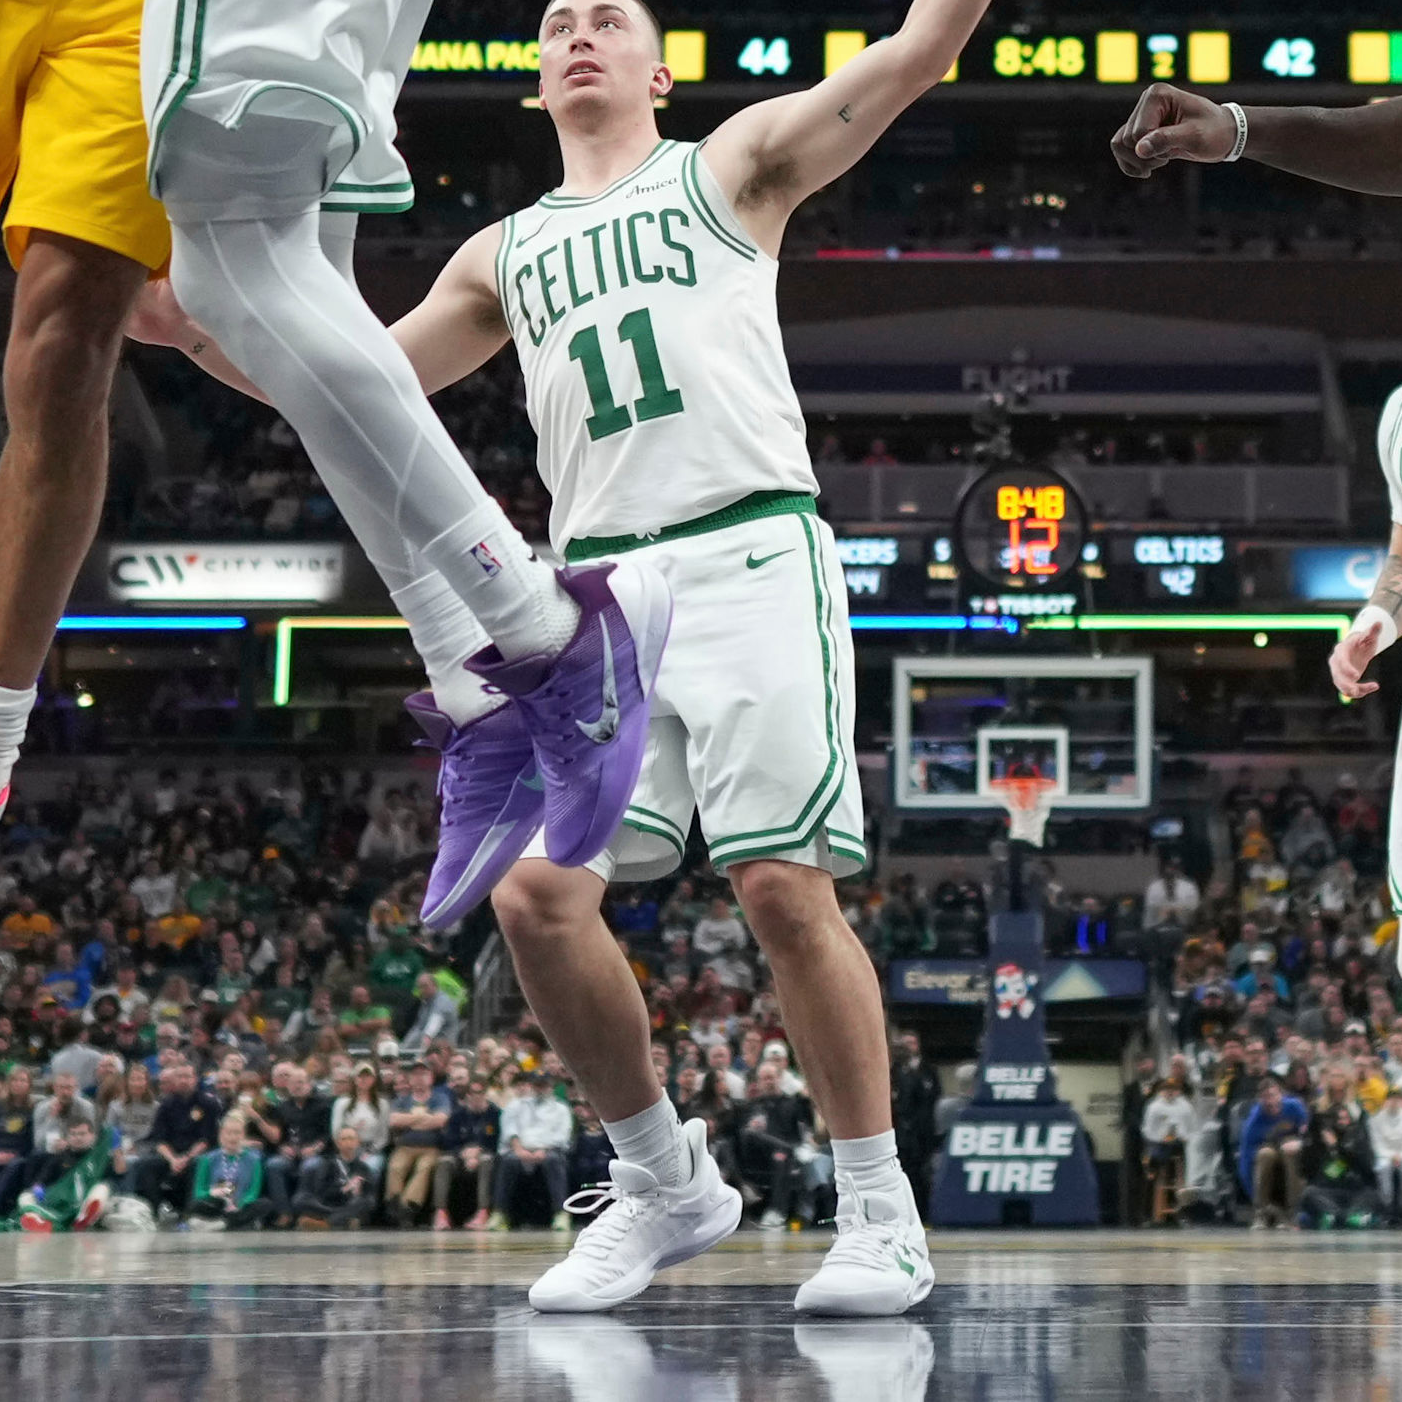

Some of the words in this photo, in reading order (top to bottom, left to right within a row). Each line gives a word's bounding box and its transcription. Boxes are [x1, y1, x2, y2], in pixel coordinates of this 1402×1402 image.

[410, 40, 484, 71] IANA
[486, 40, 541, 71] PAC
[738, 38, 791, 76] 44
[994, 37, 1086, 77] 8:48
[1152, 51, 1175, 78] 2
[1262, 38, 1316, 78] 42
[625, 175, 678, 200] Amica
[515, 208, 698, 347] CELTICS
[567, 306, 685, 443] 11
[997, 485, 1066, 521] 8:48
[204, 559, 260, 573] CITY
[274, 557, 337, 574] WIDE
[1134, 535, 1224, 565] CELTICS
[1160, 569, 1195, 597] 42
[1000, 594, 1077, 616] TISSOT
[984, 1065, 1046, 1084] BELLE
[991, 1083, 1039, 1100] TIRE
[948, 1124, 1076, 1158] BELLE
[962, 1161, 1059, 1194] TIRE
